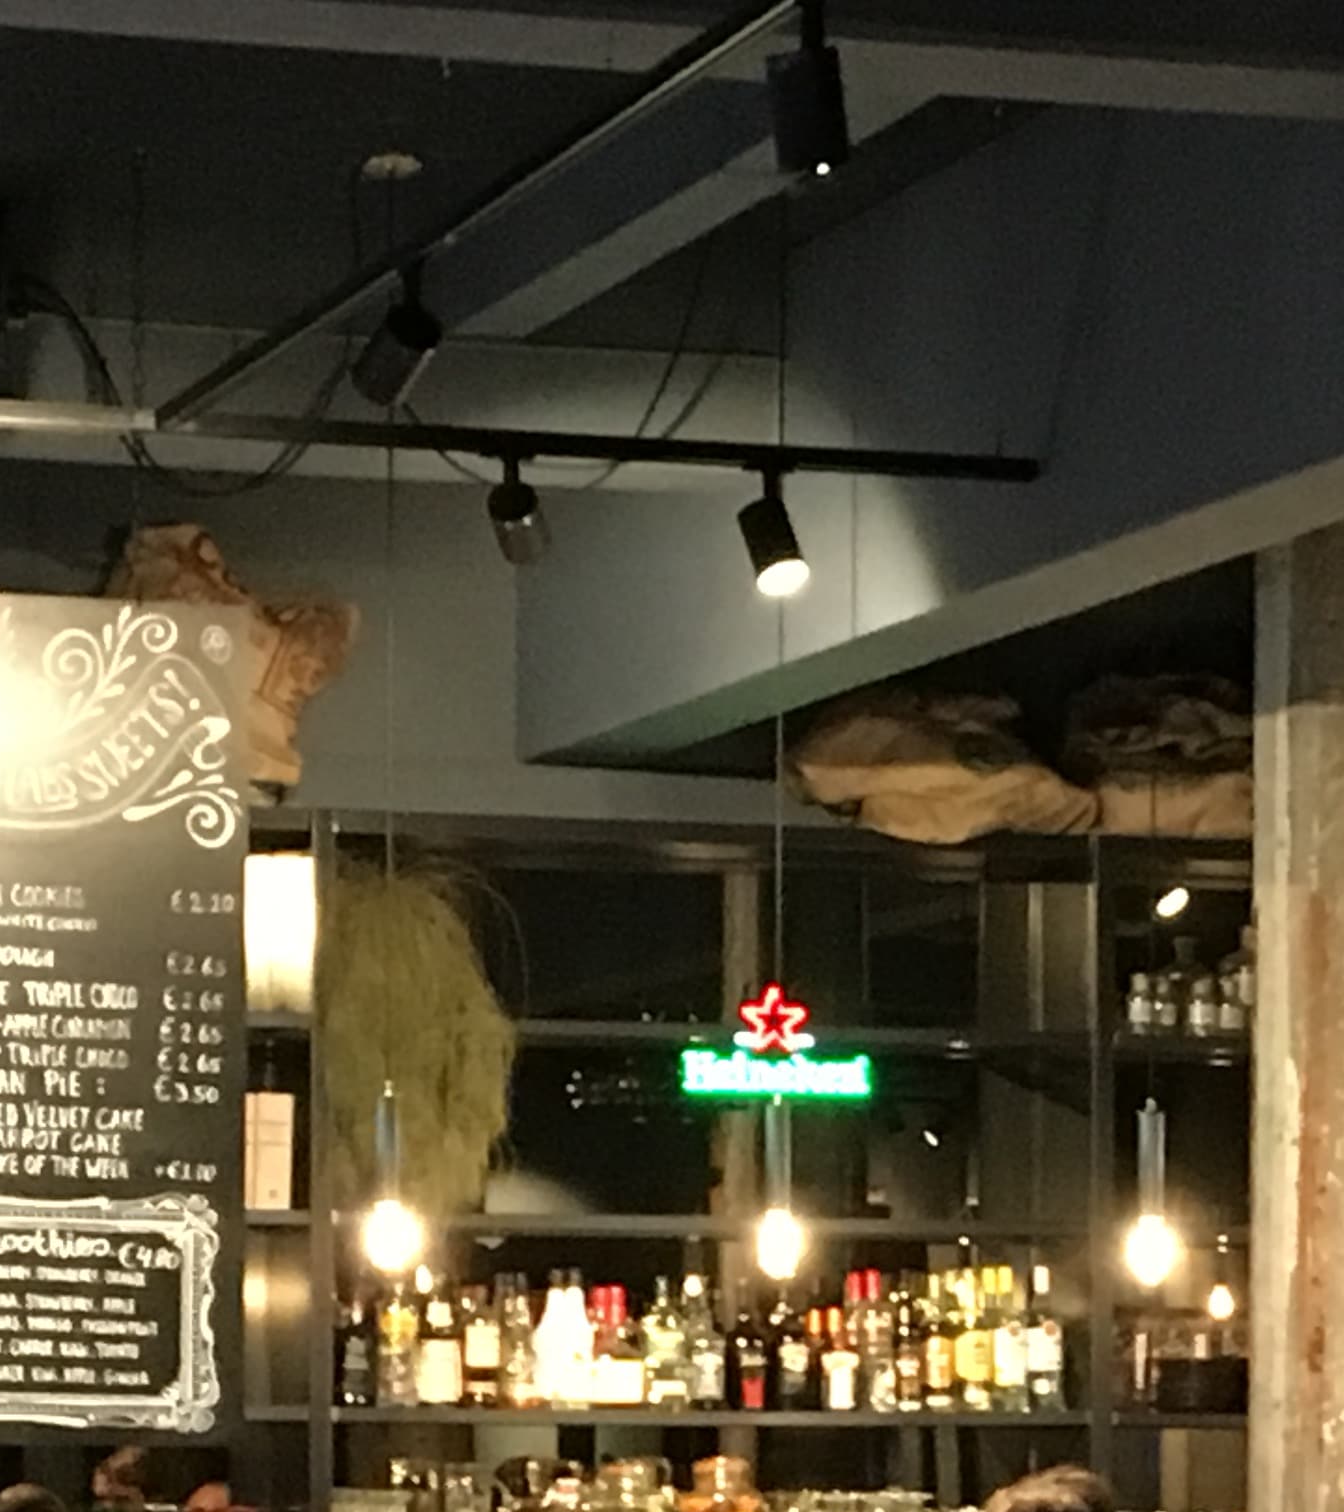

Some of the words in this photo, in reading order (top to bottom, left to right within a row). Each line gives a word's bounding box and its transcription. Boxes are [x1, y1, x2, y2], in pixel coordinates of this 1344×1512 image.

[77, 669, 200, 801] SWEETS!
[22, 1102, 91, 1129] VELVET
[94, 1107, 145, 1132] CAKE
[23, 1154, 47, 1177] OF
[50, 1154, 82, 1178] THE
